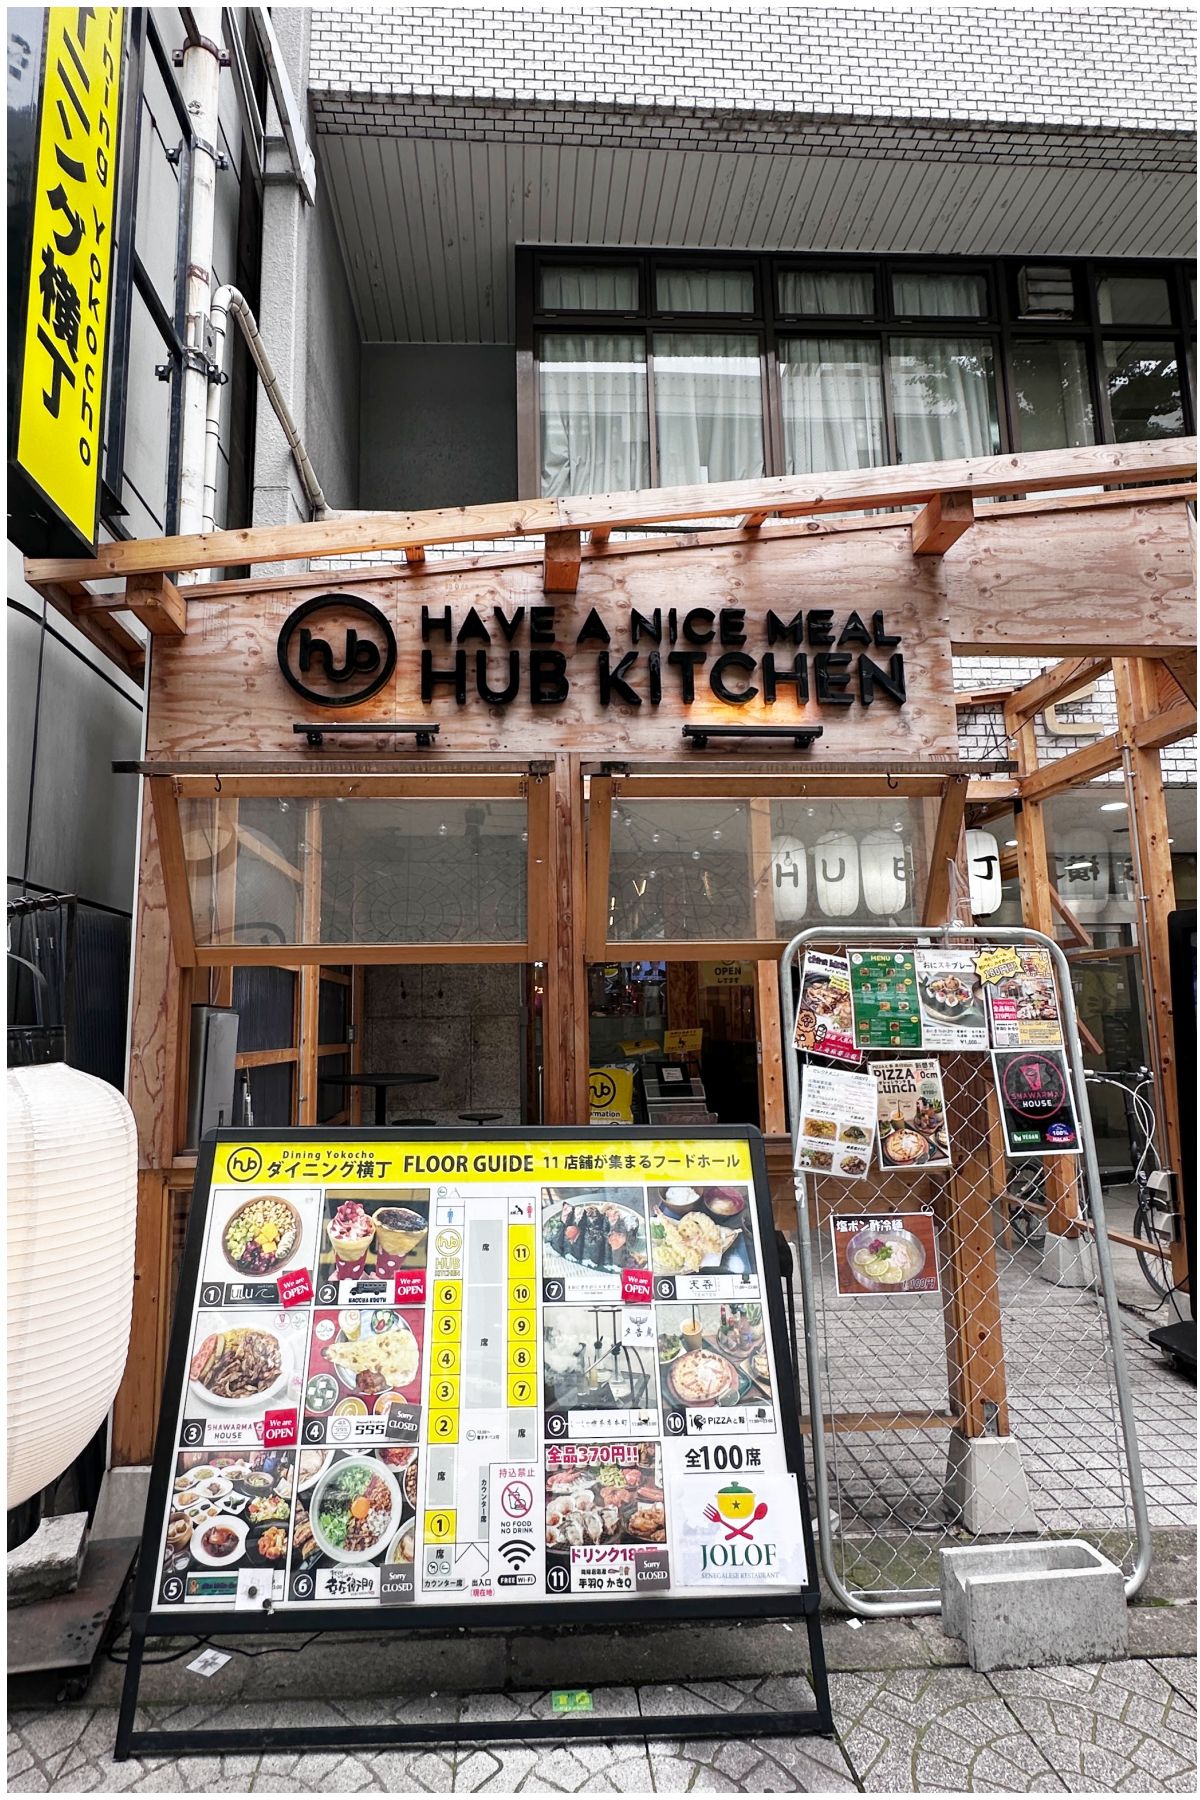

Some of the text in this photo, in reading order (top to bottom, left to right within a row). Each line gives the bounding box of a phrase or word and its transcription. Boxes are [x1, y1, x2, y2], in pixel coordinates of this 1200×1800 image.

[420, 605, 903, 648] HAVE A NICE MEAL
[300, 628, 380, 682] hub
[420, 649, 908, 707] HUB KITCHEN
[870, 954, 891, 962] MENU
[714, 967, 742, 976] OPEN
[873, 1068, 915, 1081] PIZZA
[1022, 1099, 1053, 1108] HOUSE
[282, 1149, 376, 1161] Dining Yokocho
[266, 1159, 394, 1179] ダイニング横丁
[403, 1154, 468, 1174] FLOOR
[472, 1154, 534, 1174] GUIDE
[516, 1248, 527, 1256] 11
[282, 1280, 295, 1290] We
[627, 1275, 639, 1283] We
[282, 1283, 310, 1300] OPEN
[397, 1285, 424, 1296] OPEN
[444, 1289, 453, 1301] 6
[516, 1288, 528, 1297] 10
[624, 1283, 651, 1296] OPEN
[443, 1320, 452, 1332] 5
[517, 1320, 526, 1333] 9
[441, 1353, 451, 1365] 4
[517, 1351, 527, 1364] 8
[440, 1385, 449, 1398] 3
[518, 1384, 527, 1397] 7
[396, 1410, 415, 1421] Sorry
[206, 1423, 253, 1431] SHAWARMA
[388, 1419, 418, 1432] CLOSED
[439, 1419, 449, 1432] 2
[668, 1416, 682, 1429] 10
[214, 1431, 242, 1439] HOUSE
[264, 1427, 295, 1440] OPEN
[517, 1428, 527, 1438] 席
[547, 1444, 639, 1464] 全品370円!!
[684, 1444, 762, 1471] 全100席
[436, 1471, 446, 1481] 席
[498, 1467, 536, 1479] 持込禁止
[435, 1549, 445, 1560] 席
[571, 1546, 658, 1564] ドリンク18
[700, 1543, 777, 1571] JOLOF
[643, 1560, 661, 1569] Sorry
[388, 1571, 407, 1581] Sorry
[551, 1571, 564, 1587] 11
[637, 1570, 668, 1580] CLOSED
[701, 1571, 780, 1579] SENEGALESE RESTAURANT
[381, 1582, 413, 1593] CLOSED
[424, 1579, 463, 1588] カウンター席
[471, 1579, 492, 1587] 出入口
